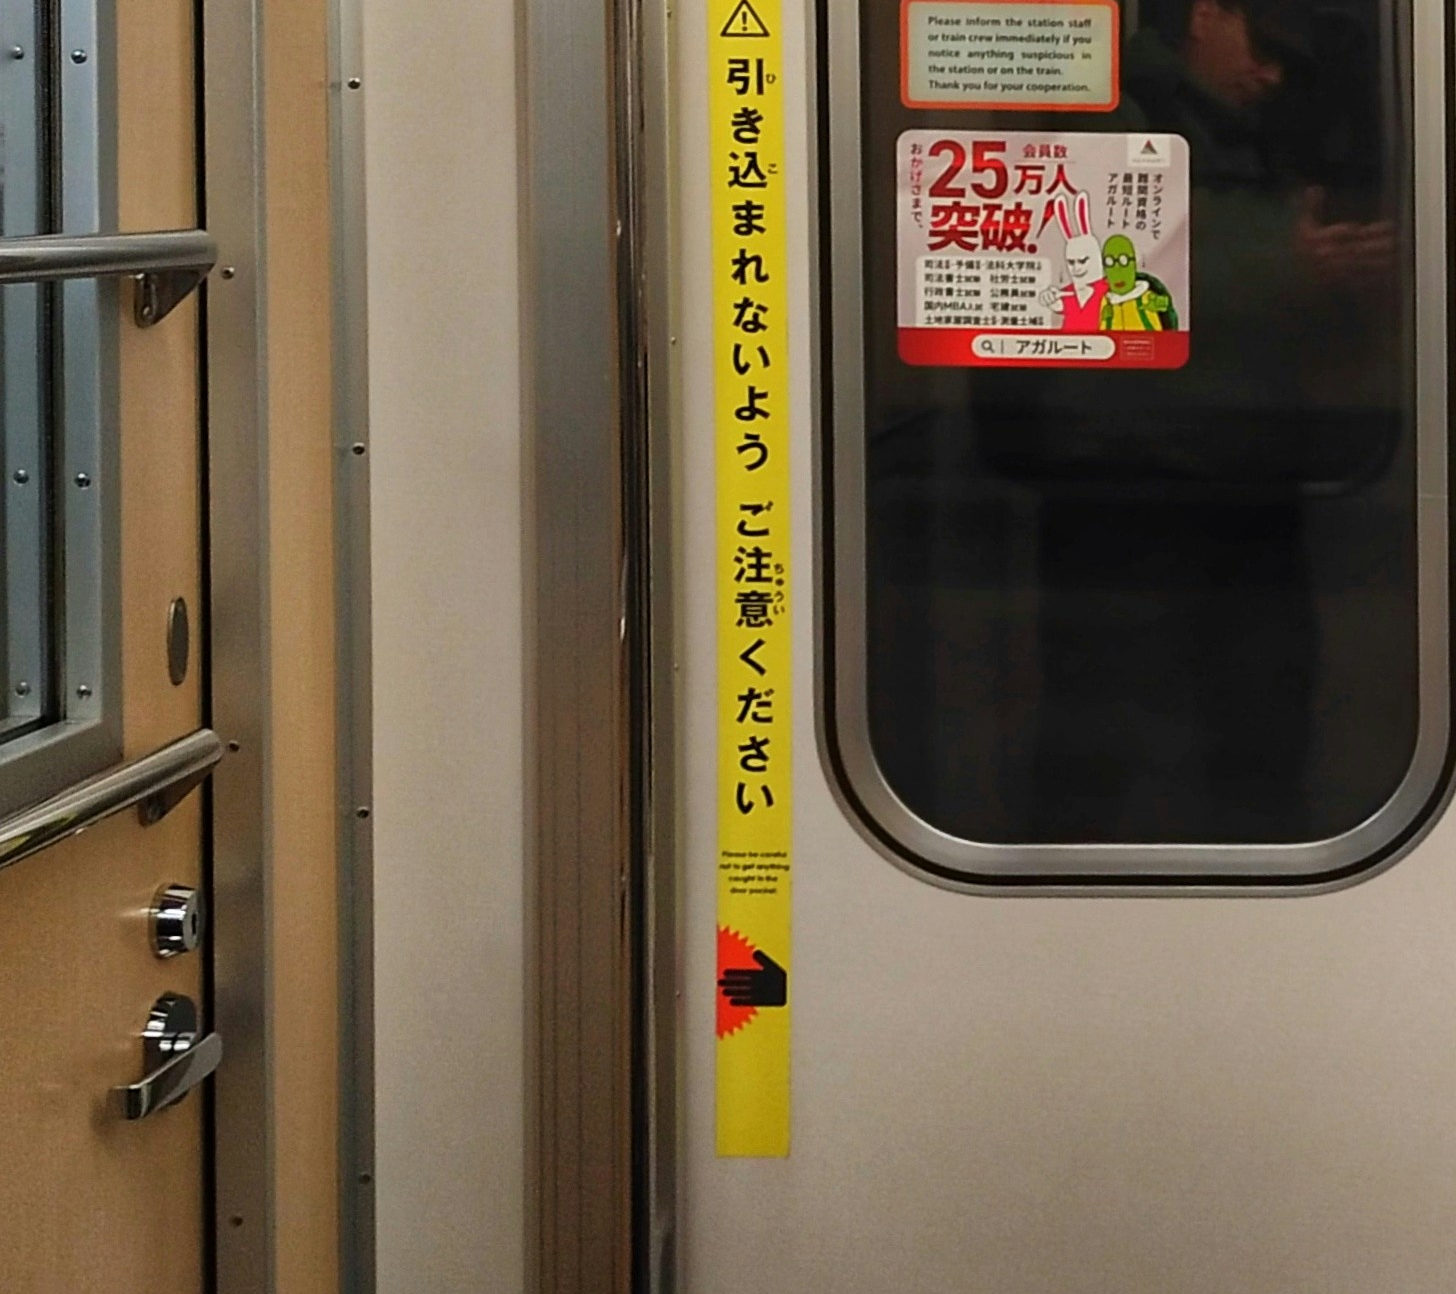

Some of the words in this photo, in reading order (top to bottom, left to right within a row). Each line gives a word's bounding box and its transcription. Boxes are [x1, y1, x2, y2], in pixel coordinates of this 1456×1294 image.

[928, 16, 962, 27] Please
[966, 16, 1001, 27] inform
[1005, 17, 1023, 27] the
[1027, 18, 1064, 28] station
[1068, 18, 1092, 28] staff
[928, 33, 939, 42] or
[941, 32, 966, 42] train
[968, 34, 993, 43] crew
[995, 33, 1061, 45] immediately
[1063, 34, 1070, 44] if
[1072, 36, 1092, 46] you
[928, 49, 960, 58] notice
[967, 49, 1015, 61] anything
[1021, 50, 1075, 60] suspicious
[1081, 51, 1092, 59] in
[928, 65, 945, 74] the
[948, 65, 984, 74] station
[987, 66, 998, 75] or
[1000, 66, 1014, 75] on
[1016, 66, 1033, 75] the
[928, 80, 960, 90] Thank
[962, 82, 982, 93] you
[983, 81, 998, 91] for
[1000, 82, 1024, 93] your
[1026, 83, 1091, 94] cooperation.
[1023, 144, 1068, 159] 会員数
[1015, 340, 1092, 354] アガルート
[734, 500, 776, 815] ご注意ください
